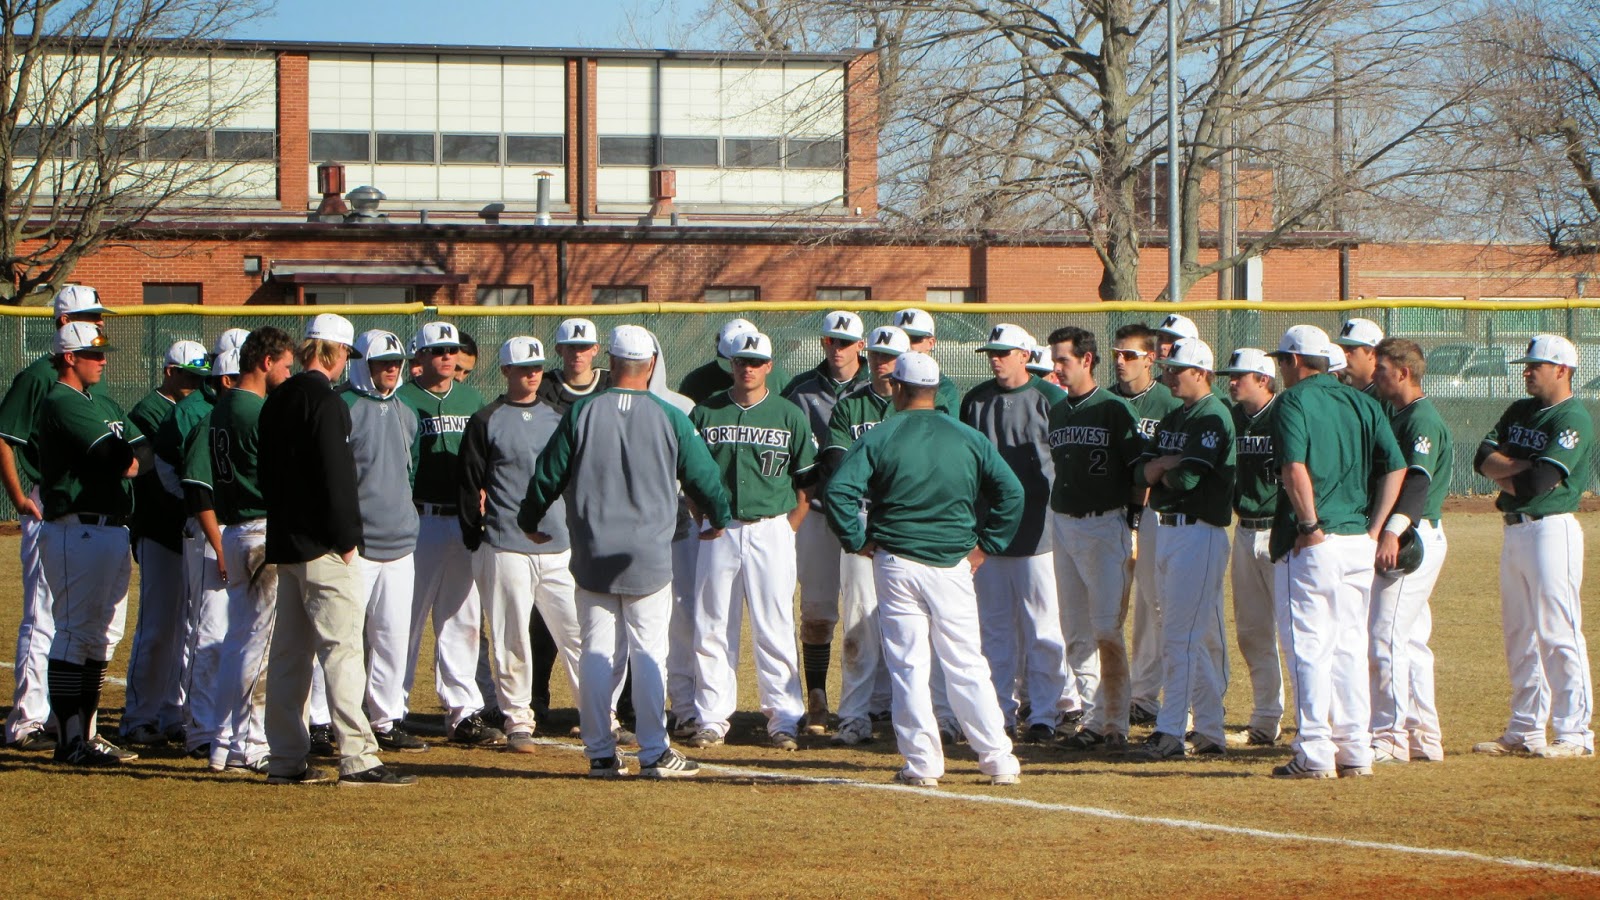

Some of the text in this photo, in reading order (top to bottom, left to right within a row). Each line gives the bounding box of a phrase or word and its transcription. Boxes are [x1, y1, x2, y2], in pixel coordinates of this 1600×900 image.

[833, 316, 851, 330] N
[900, 312, 915, 326] N
[1161, 315, 1177, 328] N
[439, 326, 452, 340] N
[572, 325, 585, 338] N
[988, 327, 1004, 342] N
[1340, 322, 1355, 337] N
[385, 334, 398, 351] N
[742, 336, 760, 350] N
[874, 331, 893, 345] N
[528, 343, 540, 358] N
[1029, 350, 1043, 364] N
[760, 449, 791, 477] 17
[1088, 449, 1108, 475] 2
